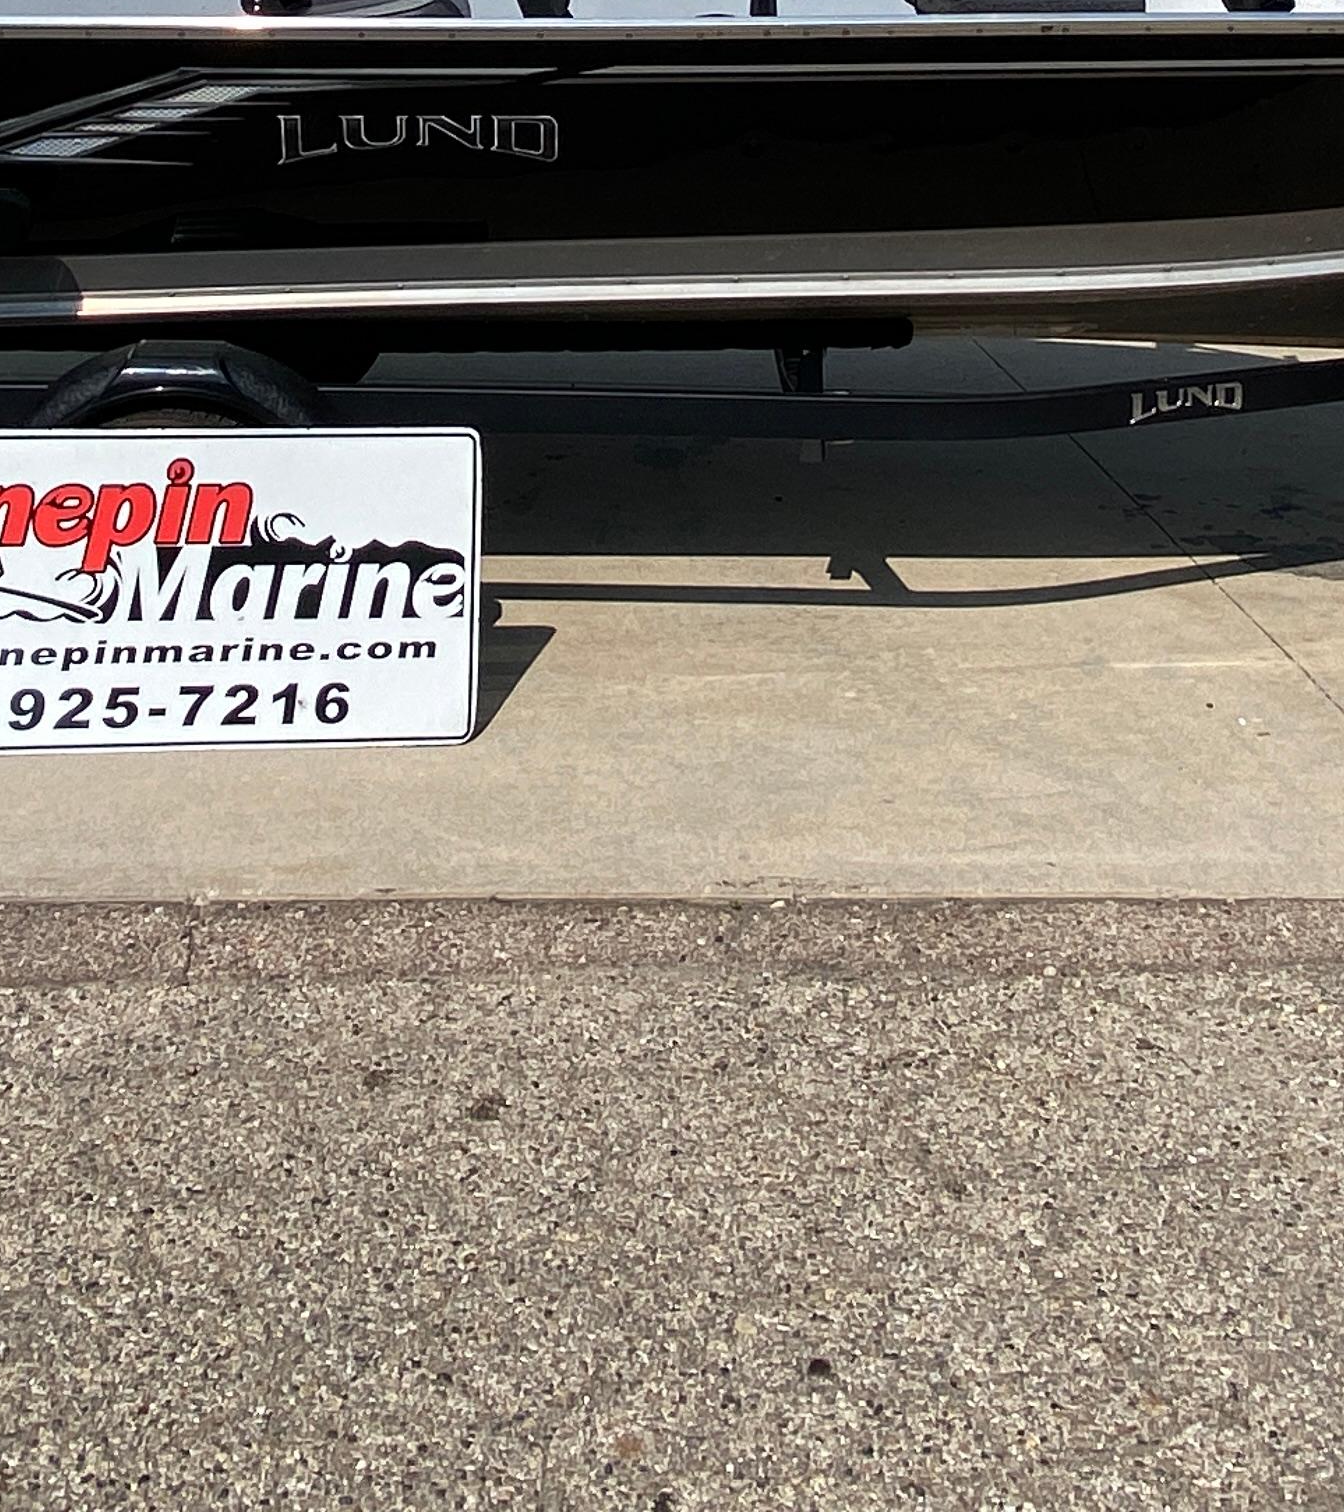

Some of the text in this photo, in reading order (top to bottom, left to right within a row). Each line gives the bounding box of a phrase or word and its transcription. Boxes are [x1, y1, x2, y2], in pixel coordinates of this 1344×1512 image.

[276, 115, 558, 165] LUND
[1130, 381, 1243, 425] LUND
[116, 544, 466, 621] Marine
